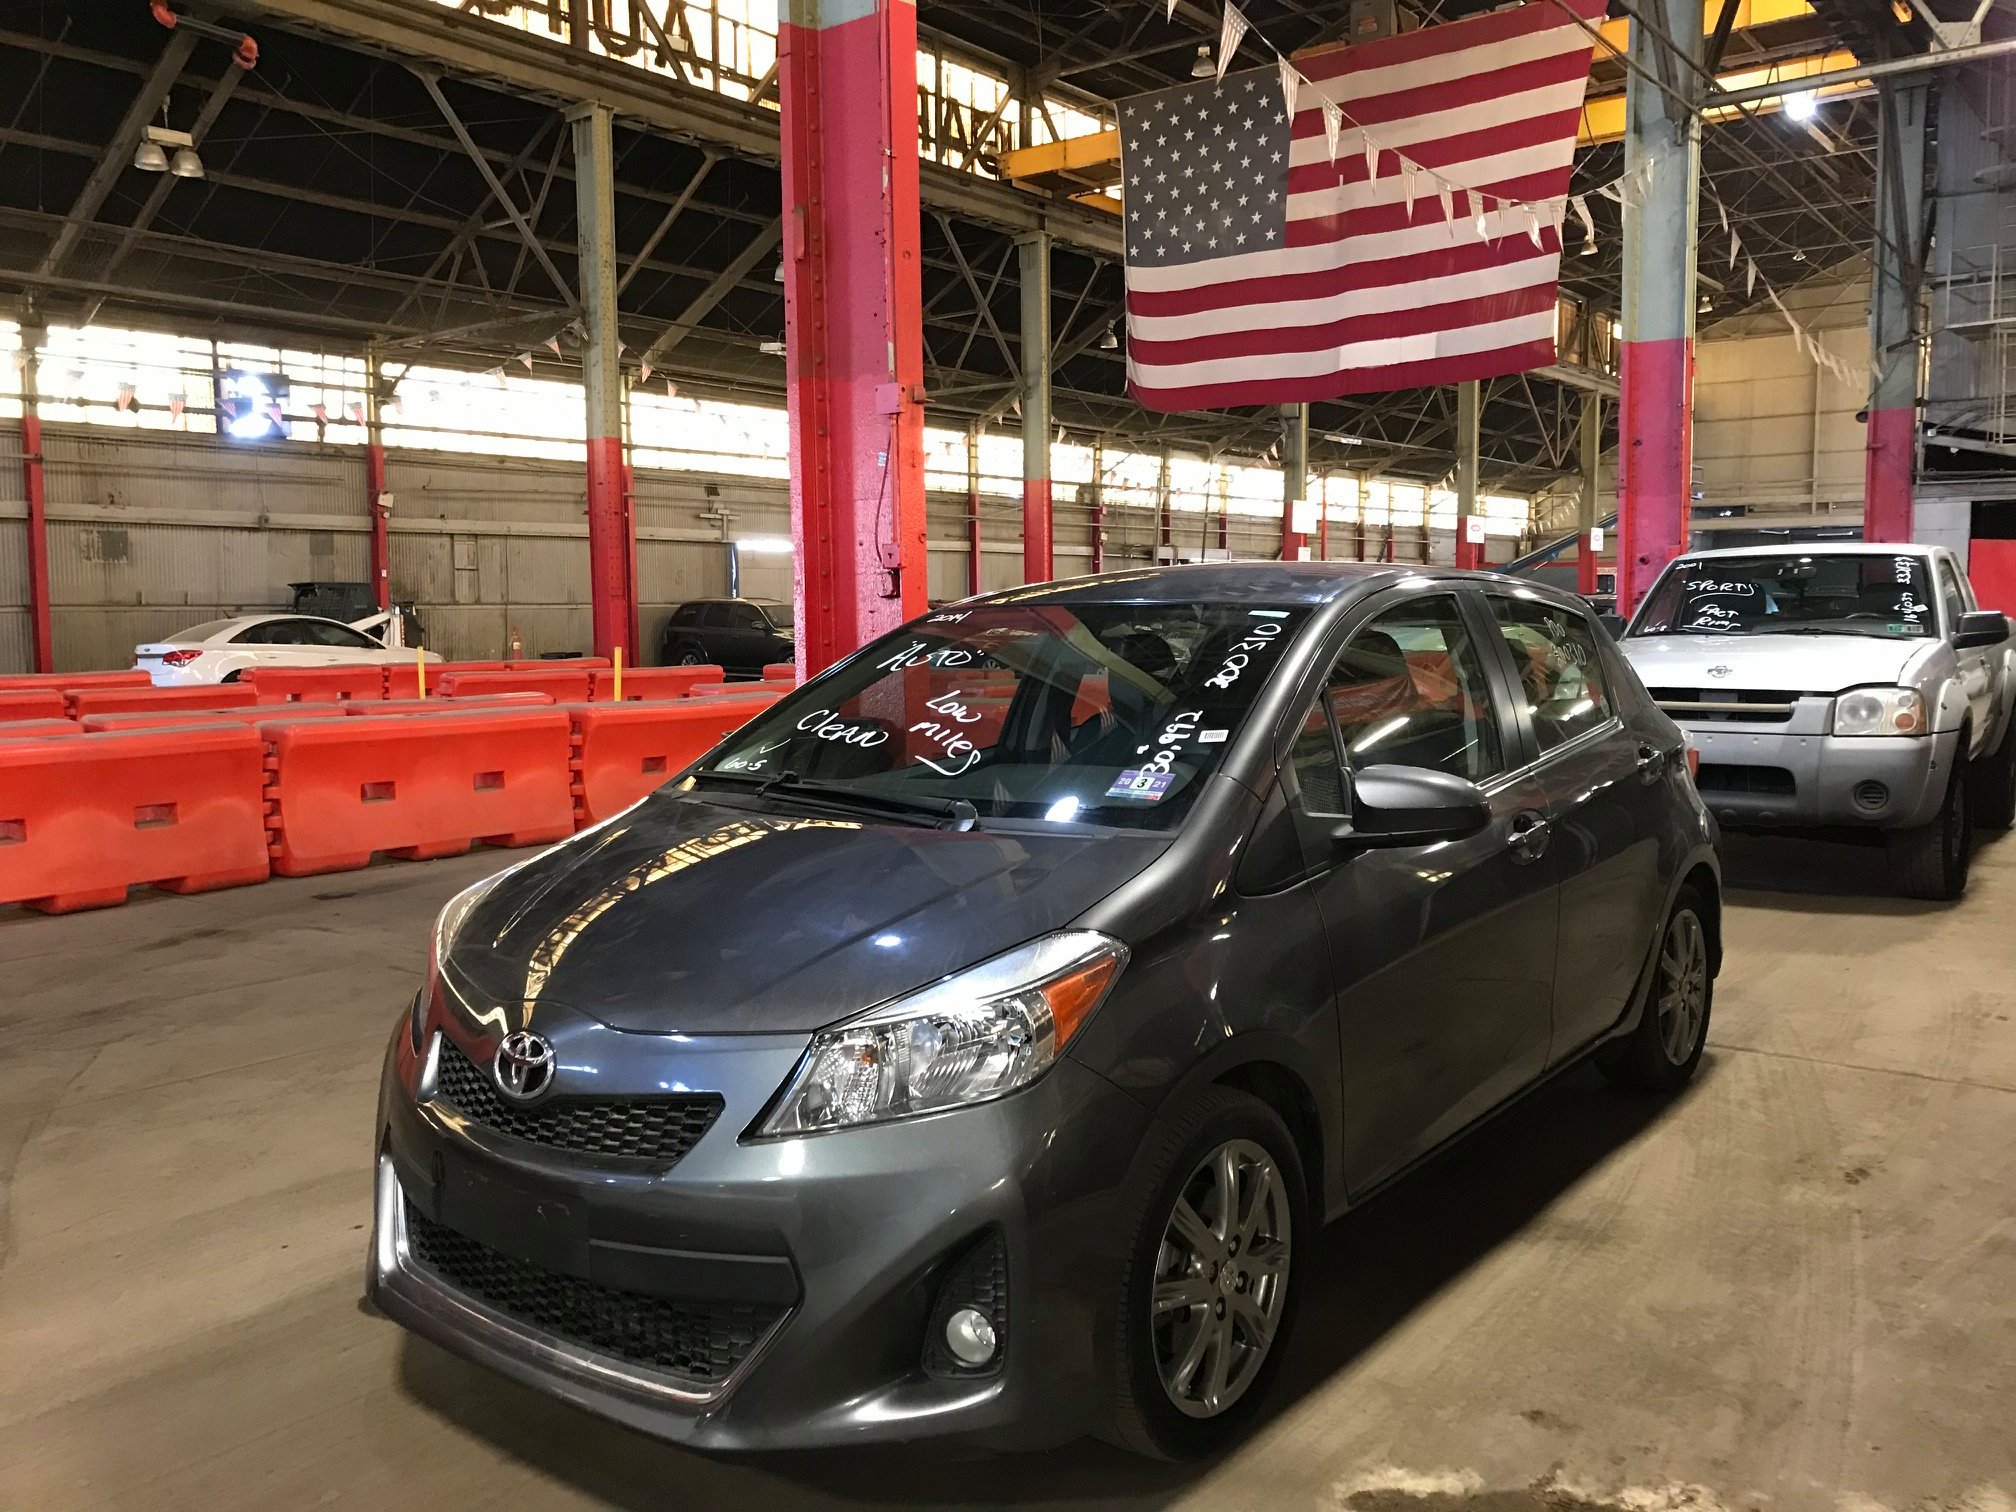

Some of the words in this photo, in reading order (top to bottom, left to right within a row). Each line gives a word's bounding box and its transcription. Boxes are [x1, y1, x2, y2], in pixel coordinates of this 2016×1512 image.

[927, 610, 973, 623] 2014
[1117, 777, 1132, 785] 20
[1136, 778, 1148, 788] 3
[1152, 780, 1167, 789] 21
